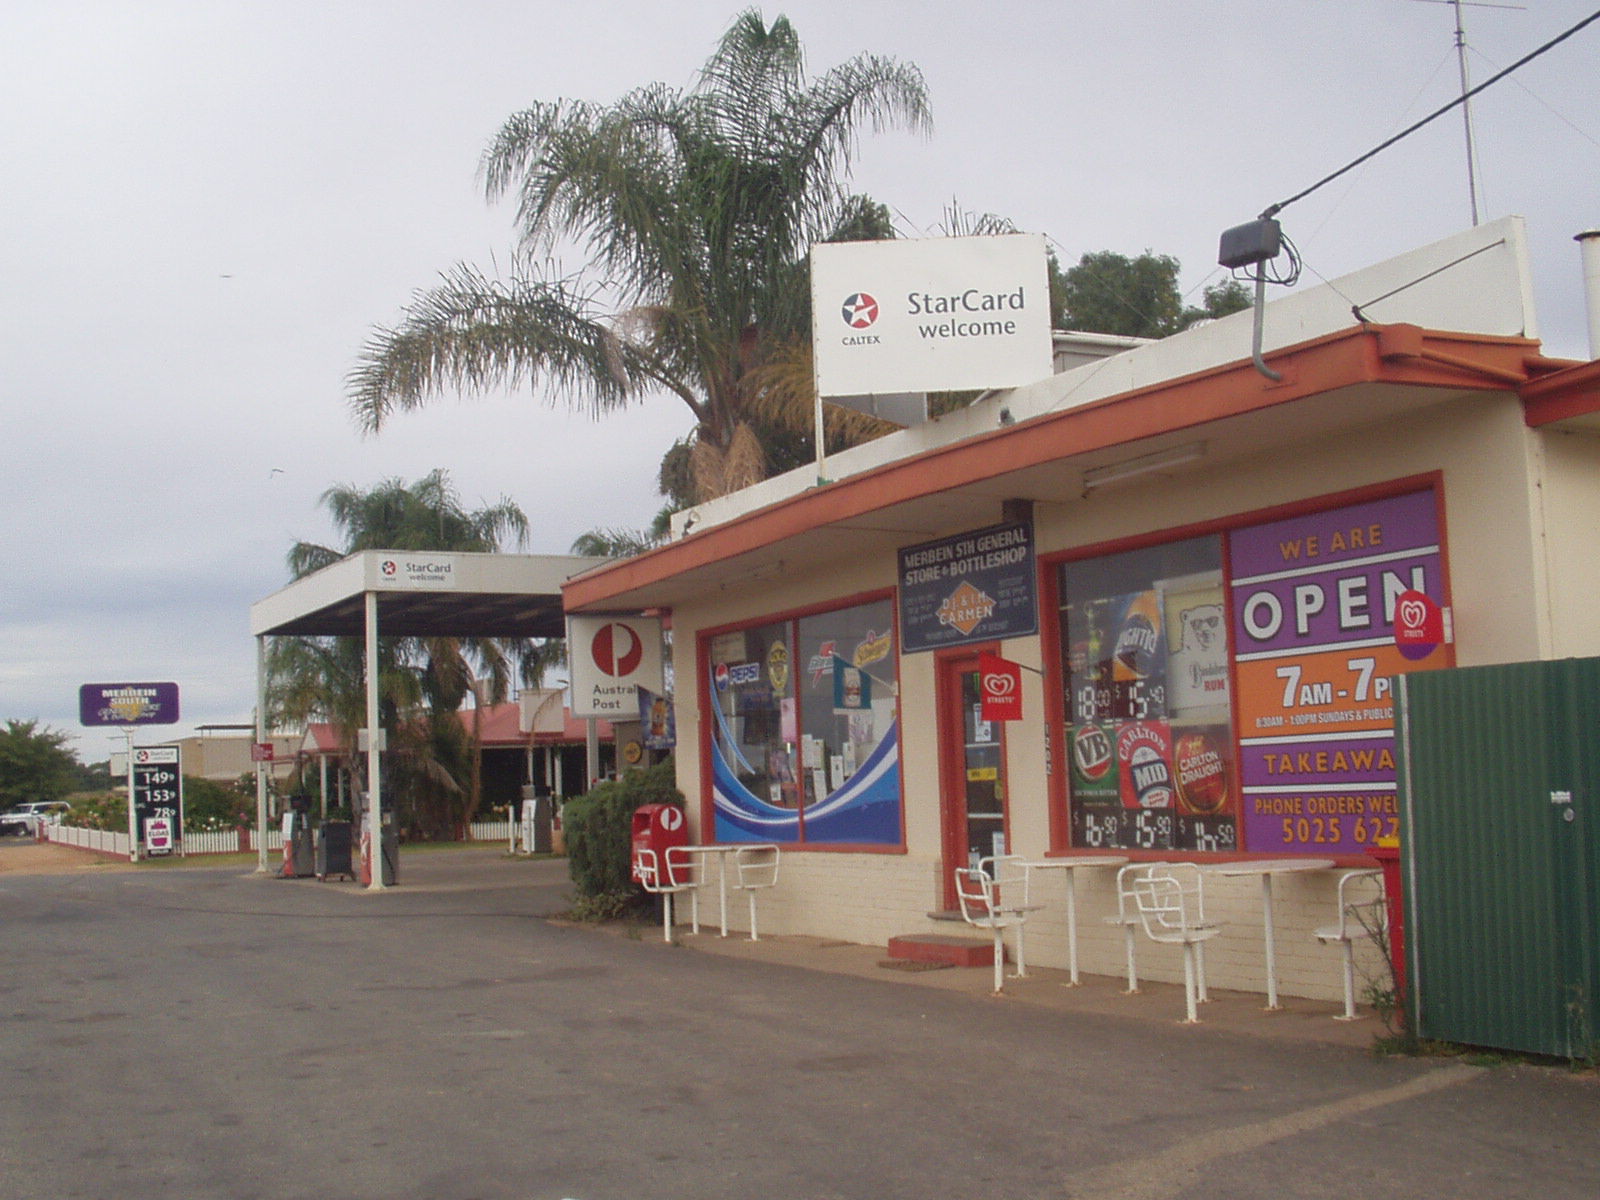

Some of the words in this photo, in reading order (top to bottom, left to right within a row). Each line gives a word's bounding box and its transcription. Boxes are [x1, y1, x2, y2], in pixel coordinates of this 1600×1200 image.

[908, 287, 1024, 315] StarCard
[842, 335, 881, 346] CALTEX
[919, 319, 1016, 338] welcome
[904, 545, 953, 568] MERBEIN
[956, 541, 976, 557] STH
[977, 528, 1027, 552] GENERAL
[1280, 536, 1320, 560] WE
[1331, 524, 1383, 552] ARE
[406, 562, 451, 573] StarCard
[905, 567, 940, 586] STORE
[950, 546, 1026, 577] BOTTLESHOP
[940, 605, 993, 625] CARMEN
[1243, 566, 1426, 640] OPEN
[730, 664, 759, 683] PEPSI
[1347, 658, 1393, 701] 7P
[592, 684, 637, 695] Austral
[592, 699, 621, 709] Post
[1318, 709, 1355, 724] SUNDAYS
[1363, 706, 1394, 720] PUBLIC
[1077, 732, 1109, 767] VB
[1119, 726, 1166, 760] CARLTON
[1180, 751, 1219, 771] CARLTON
[1180, 761, 1222, 784] DRAUGHT
[1262, 748, 1395, 775] TAKEAWA
[1135, 761, 1167, 791] MID
[1255, 797, 1301, 815] PHONE
[1307, 796, 1364, 814] ORDERS
[1369, 795, 1399, 813] WEL
[1282, 817, 1341, 844] 5025
[1354, 816, 1399, 844] 627
